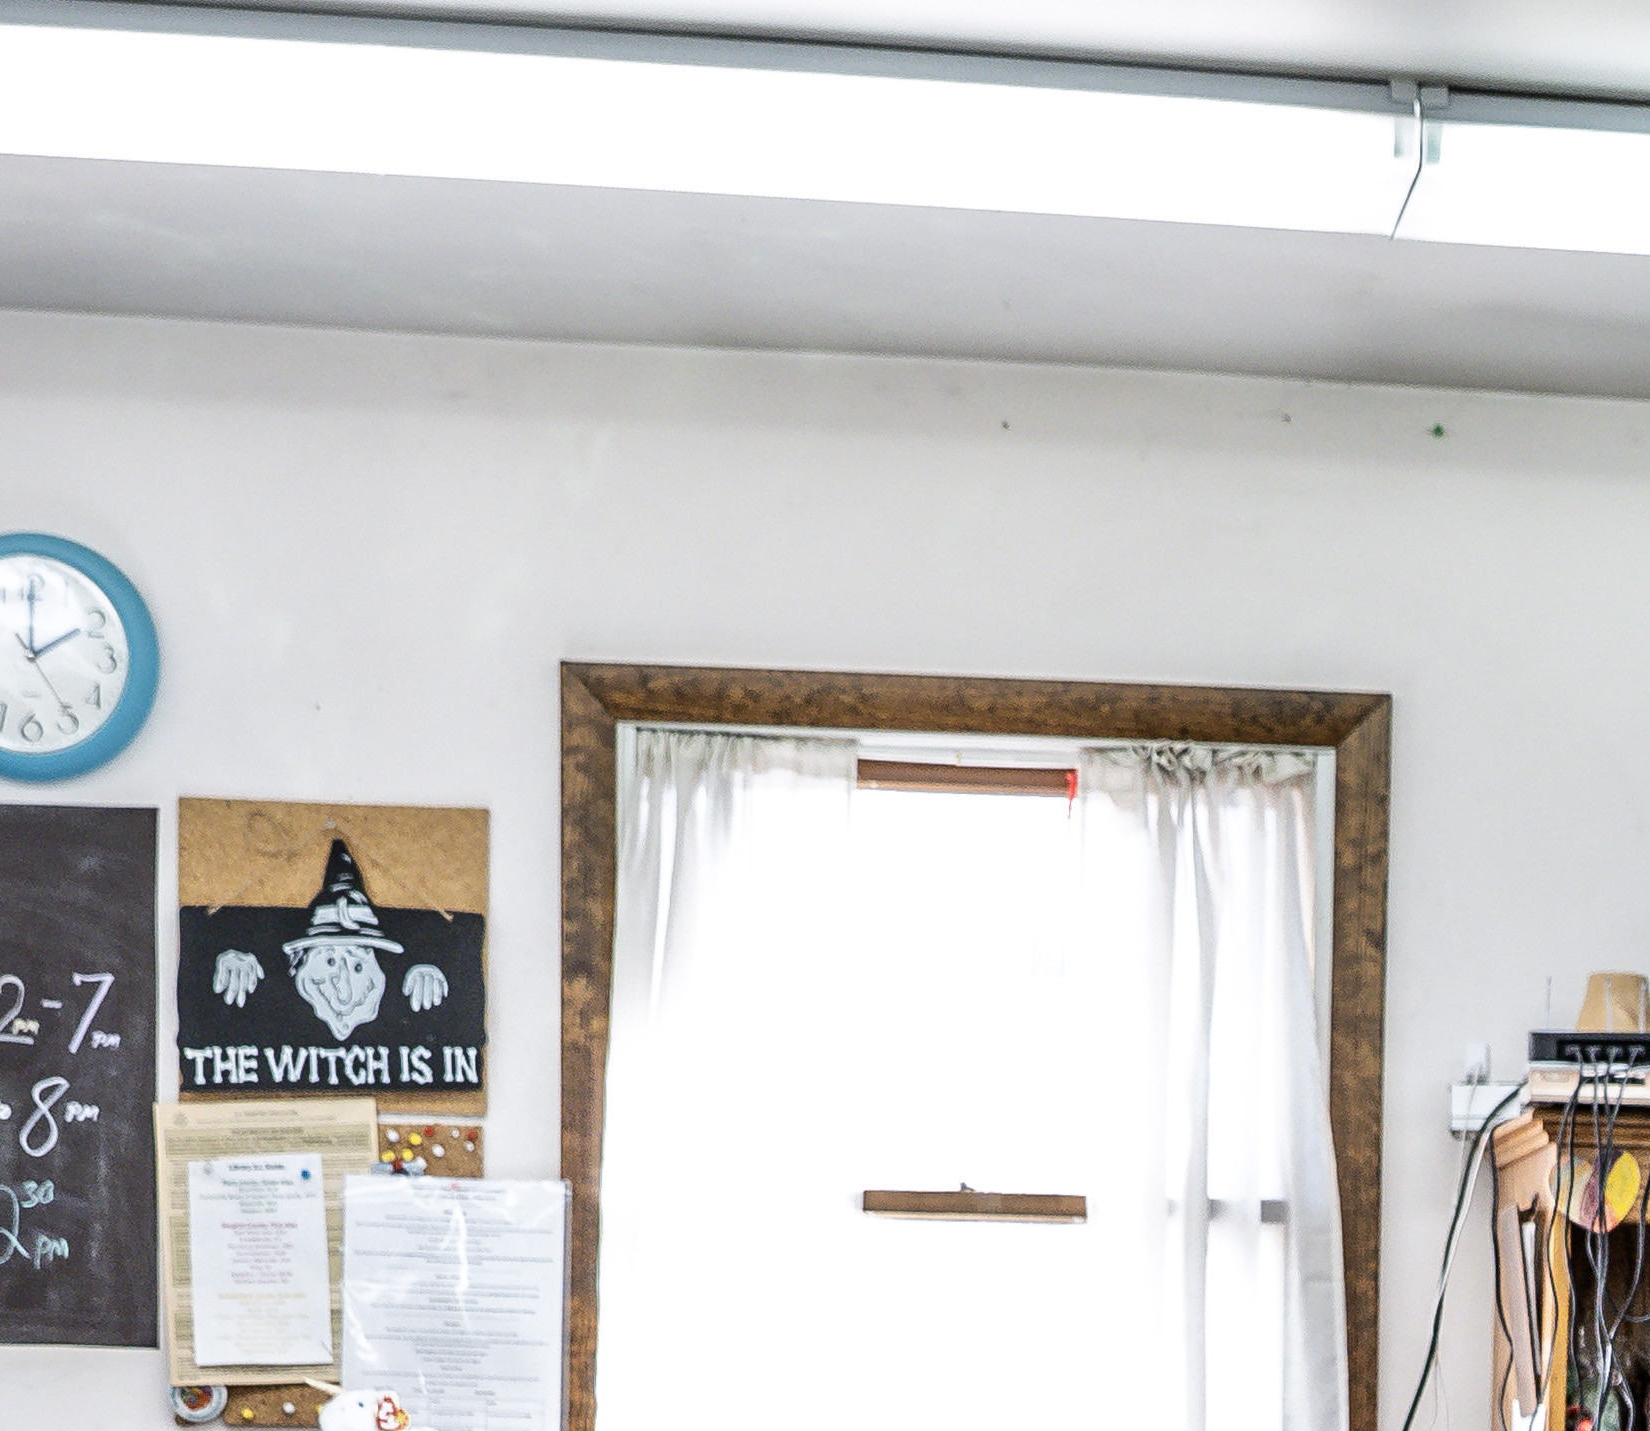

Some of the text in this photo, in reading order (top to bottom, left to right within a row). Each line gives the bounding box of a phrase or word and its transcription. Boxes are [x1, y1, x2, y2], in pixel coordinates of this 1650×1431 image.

[21, 713, 44, 743] 6
[184, 1044, 480, 1086] THE WITCH IS IN
